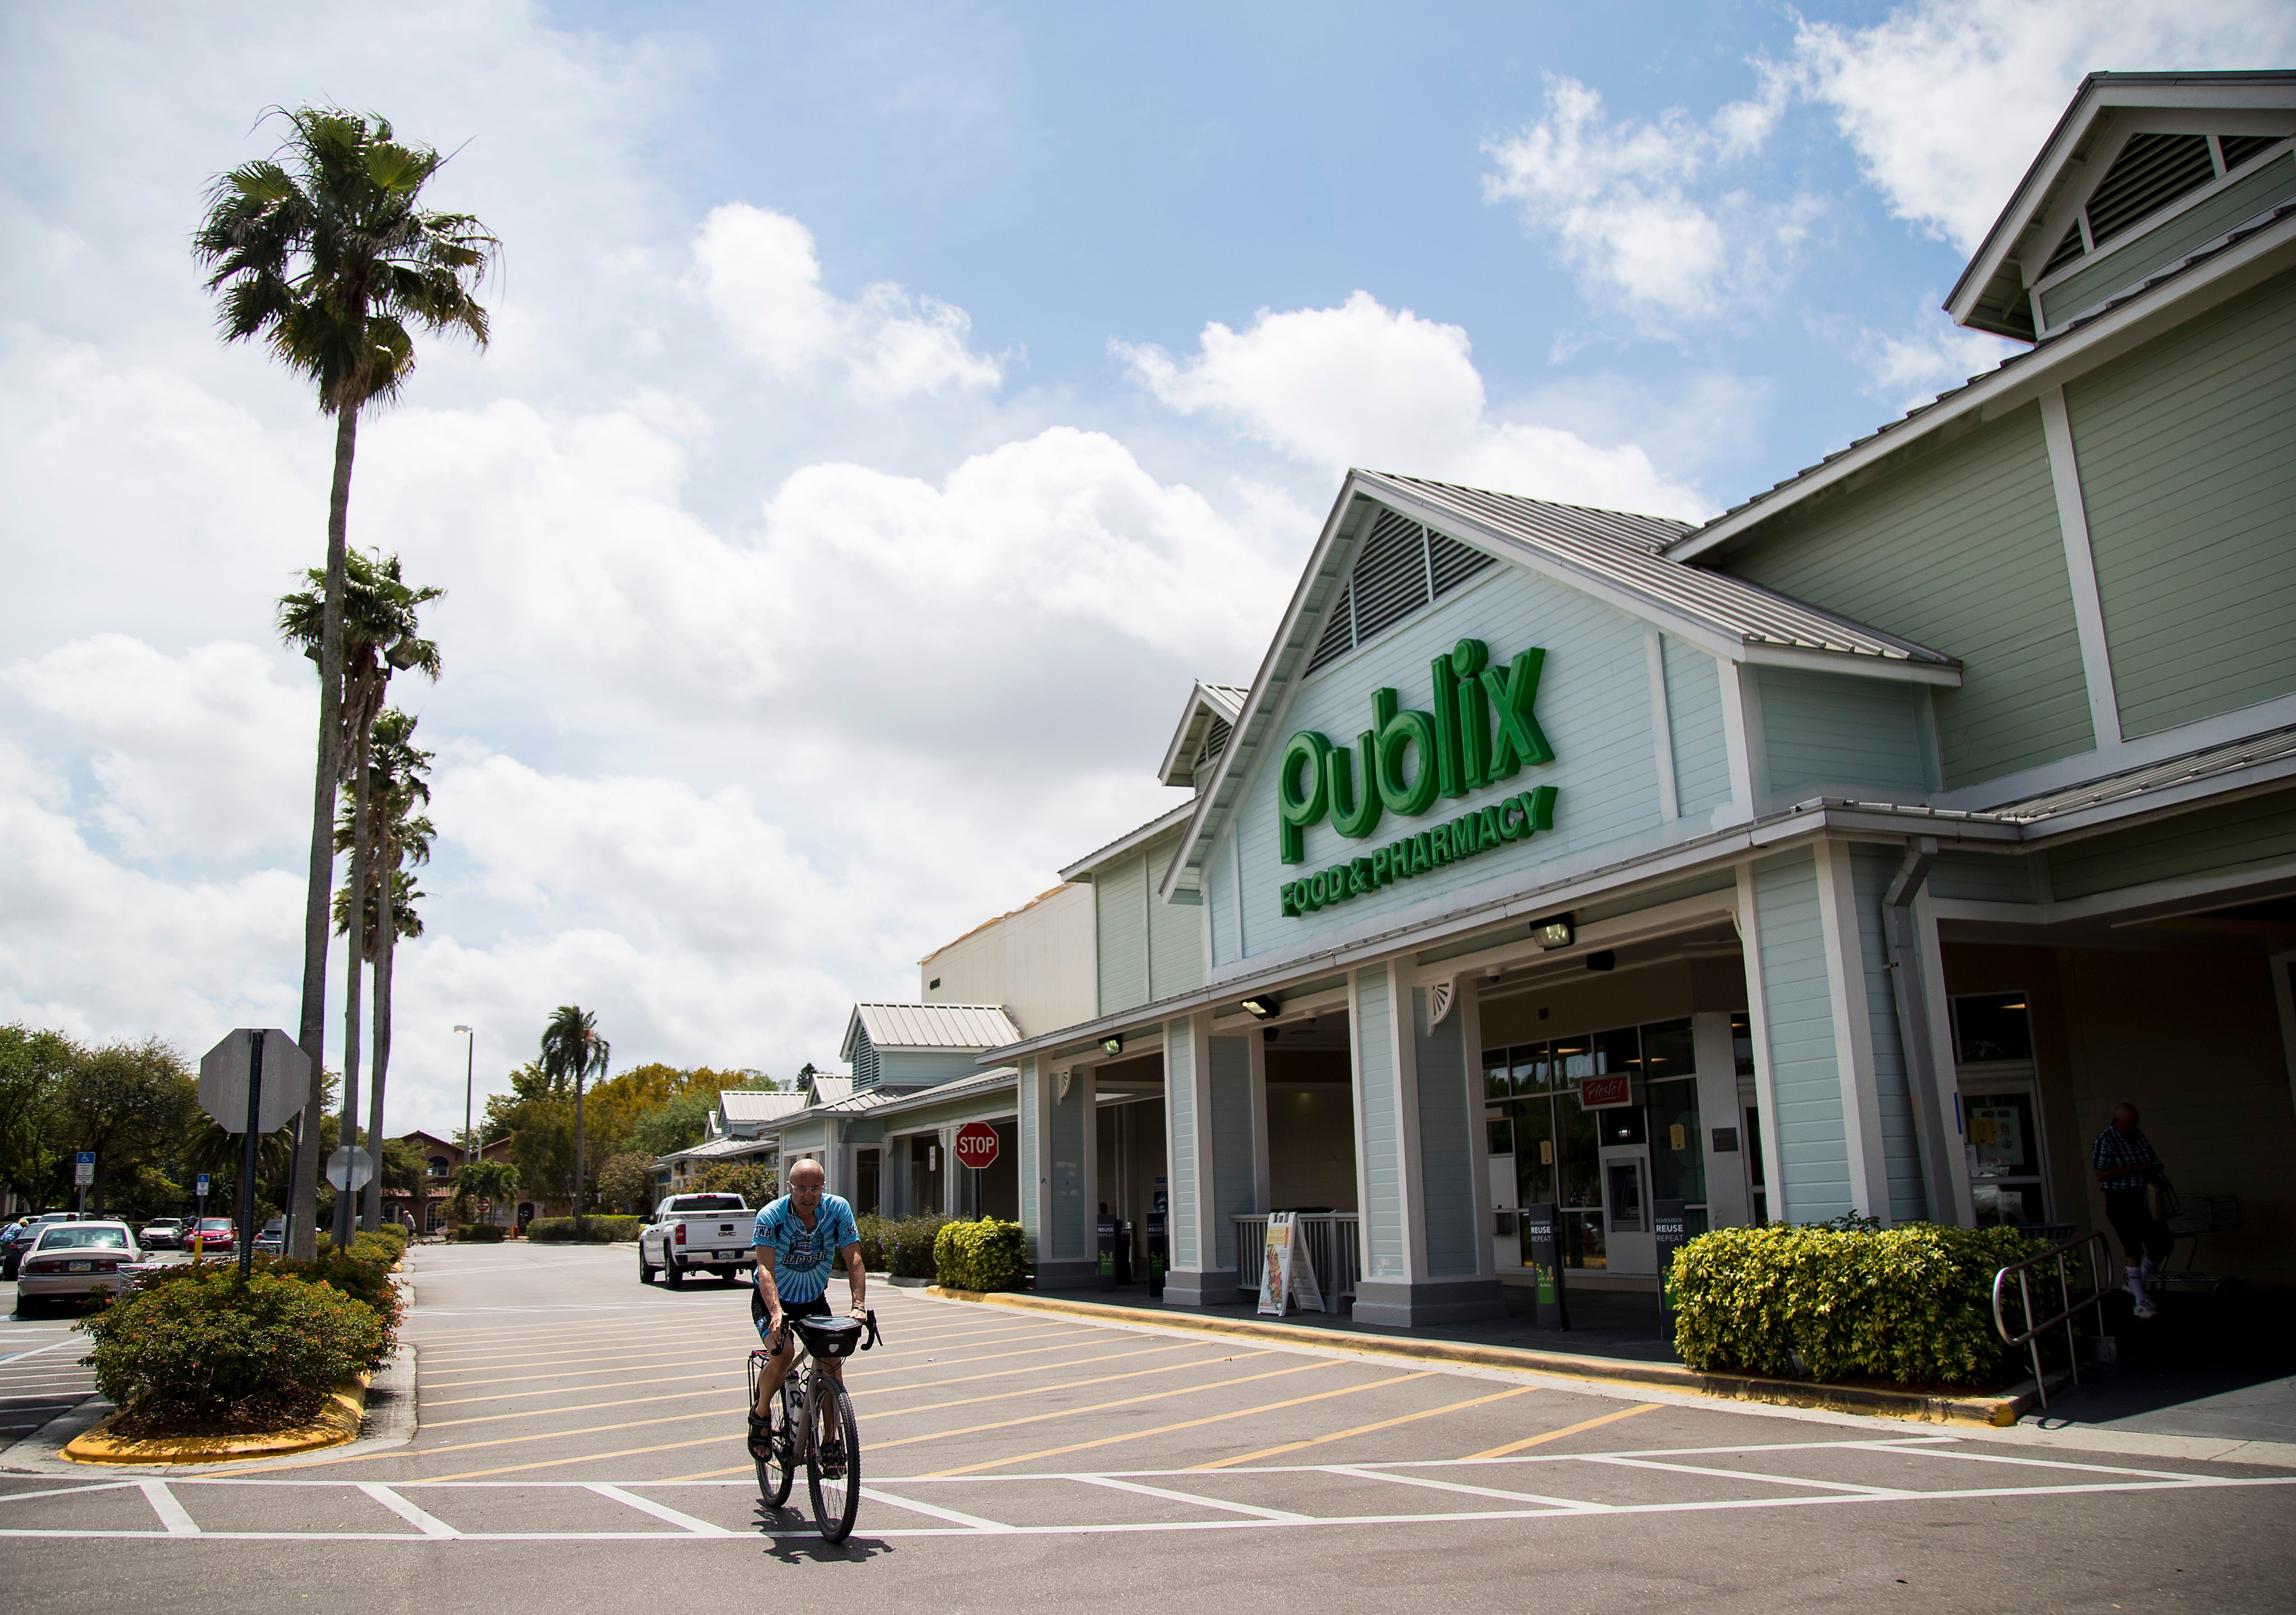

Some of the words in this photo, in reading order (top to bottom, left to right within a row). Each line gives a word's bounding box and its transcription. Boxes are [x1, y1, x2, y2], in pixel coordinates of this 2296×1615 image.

[1280, 638, 1555, 864] Publix
[1281, 864, 1351, 917] FOOD
[1349, 857, 1379, 893] &
[1372, 785, 1558, 885] PHARMACY
[959, 1136, 995, 1153] STOP
[1656, 1224, 1683, 1232] REUSE
